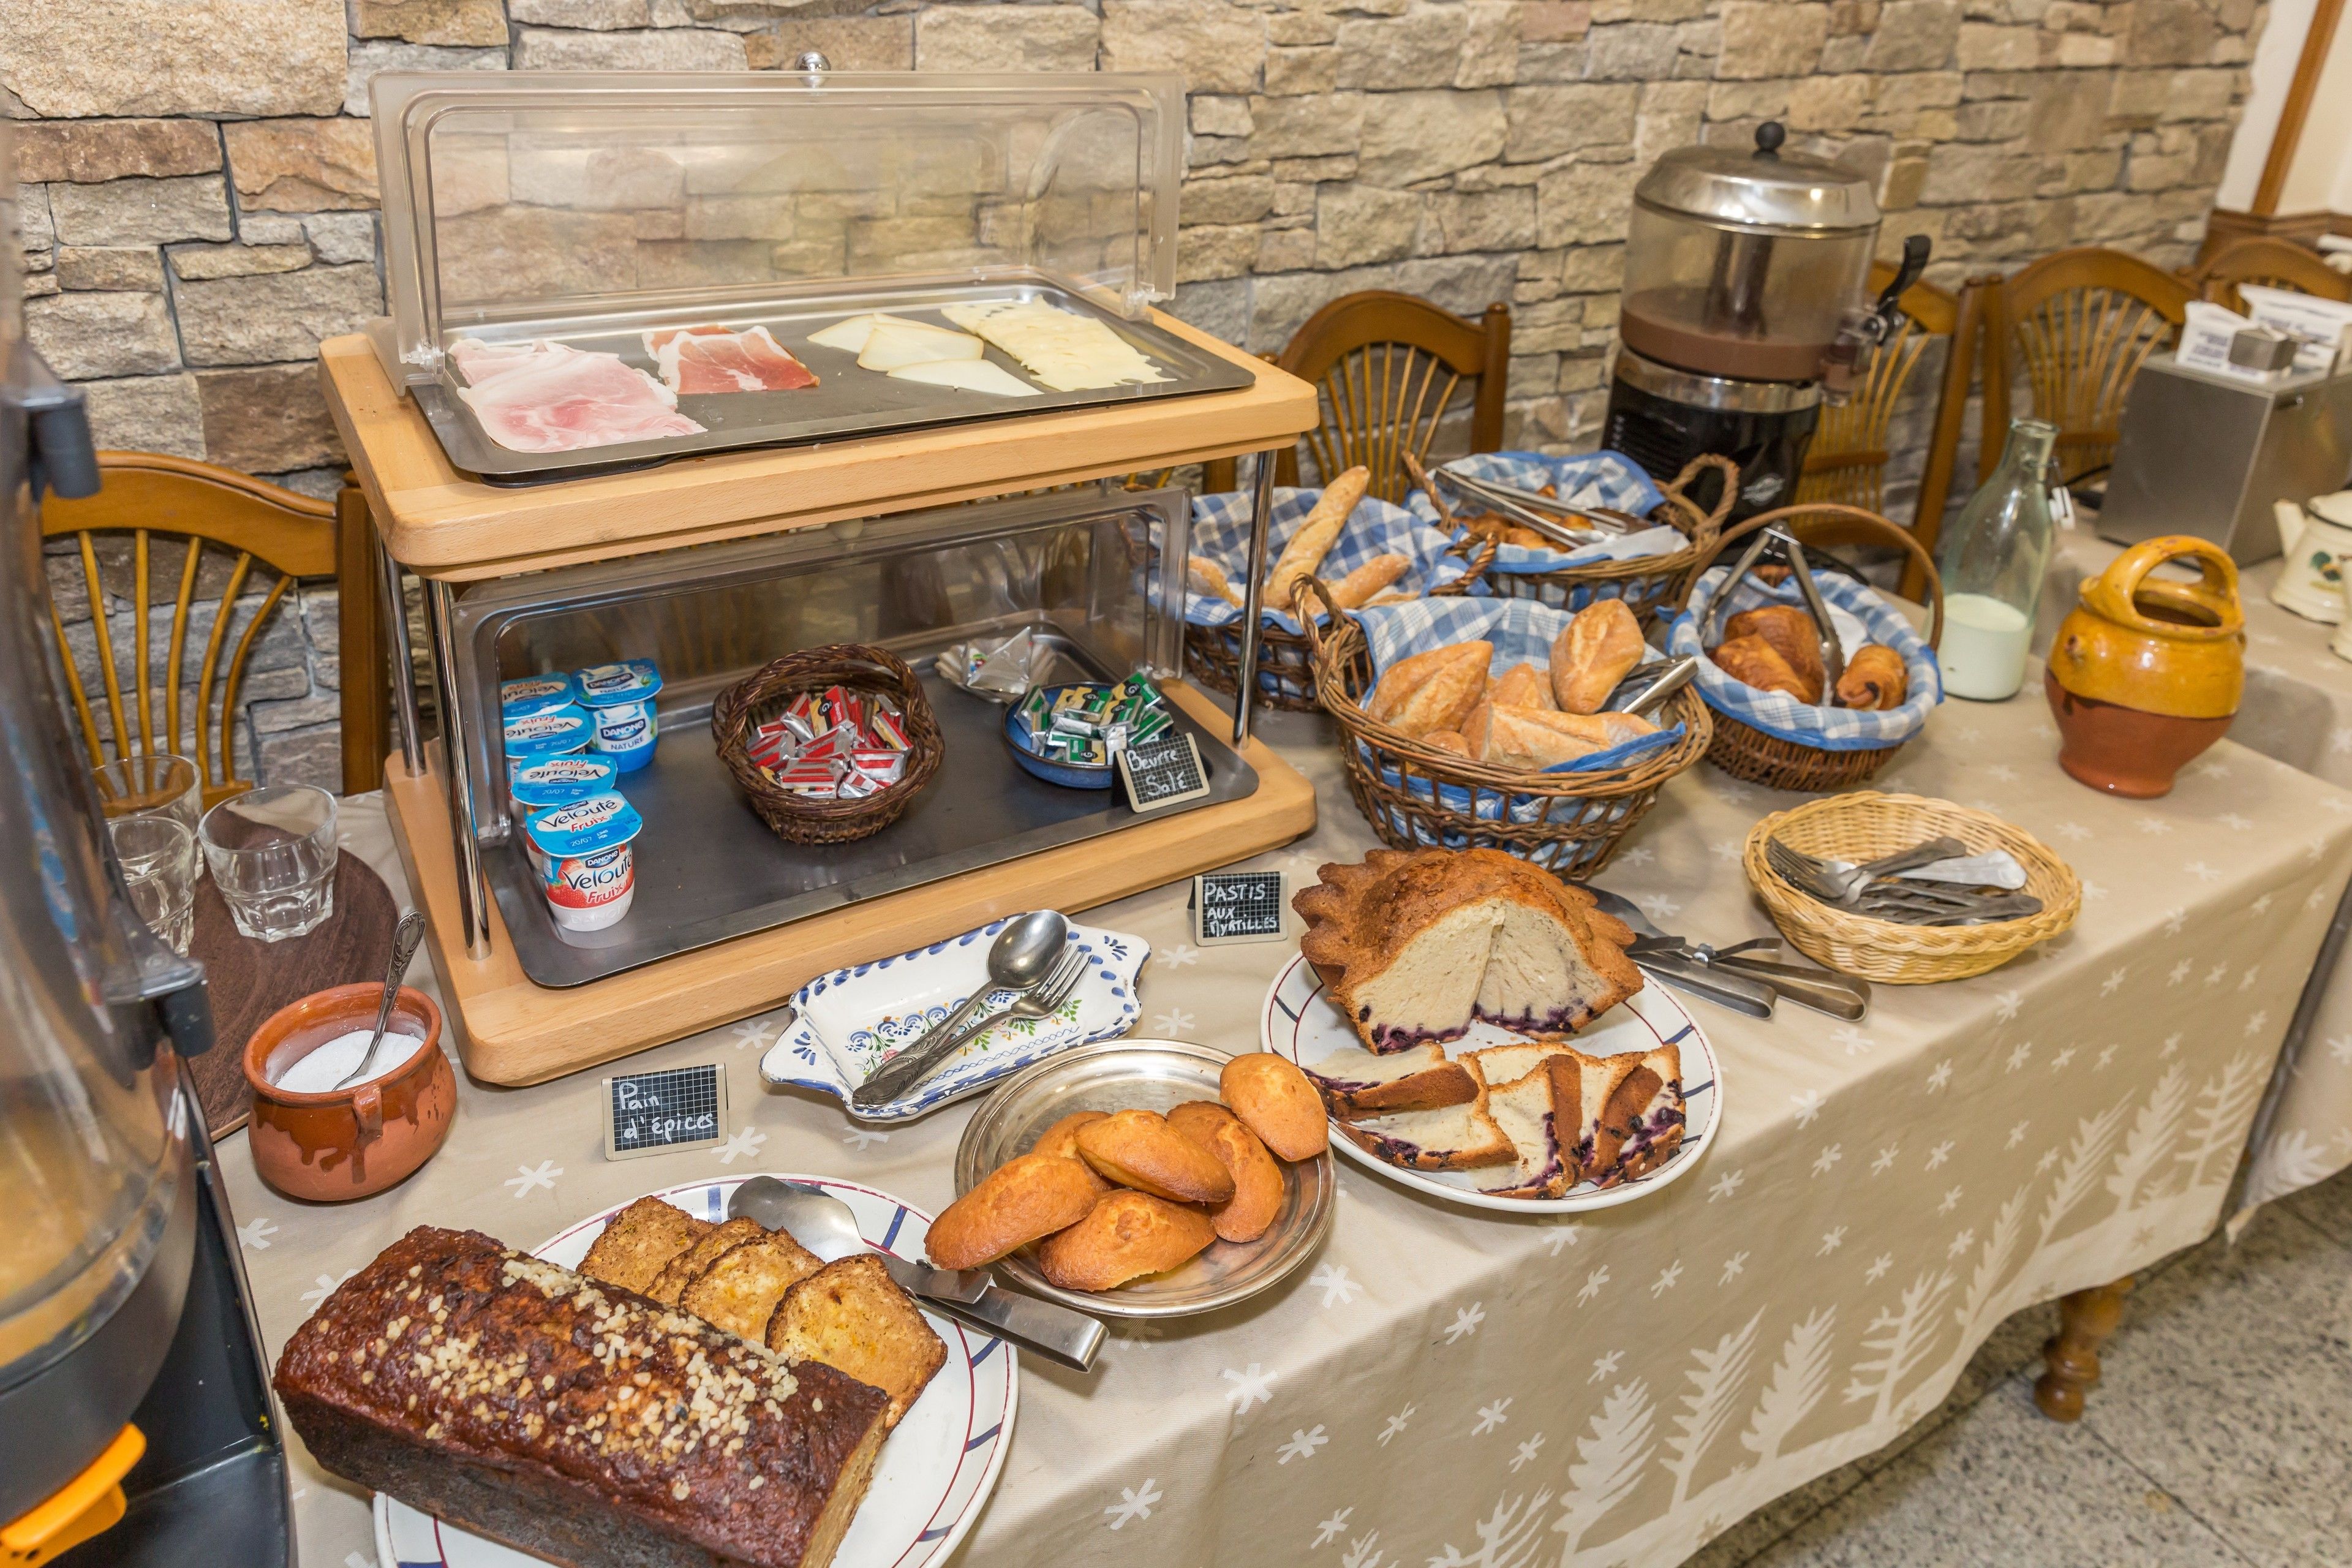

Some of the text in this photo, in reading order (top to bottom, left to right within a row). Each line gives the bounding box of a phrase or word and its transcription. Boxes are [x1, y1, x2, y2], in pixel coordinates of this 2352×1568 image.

[603, 719, 644, 737] DANONE
[611, 736, 644, 751] NATURE
[1126, 750, 1178, 772] Beurre
[529, 768, 603, 780] Velouté
[1145, 771, 1187, 796] Salé
[539, 800, 617, 827] Velouté
[571, 816, 608, 832] Fruix
[570, 837, 592, 846] 20/07
[587, 849, 619, 866] DANONE
[561, 850, 633, 890] Velouté
[587, 884, 624, 903] Fruix
[1204, 882, 1265, 905] PASTIS
[1207, 906, 1236, 919] AUX
[619, 1082, 660, 1110] Pain
[624, 1112, 714, 1142] d'épices
